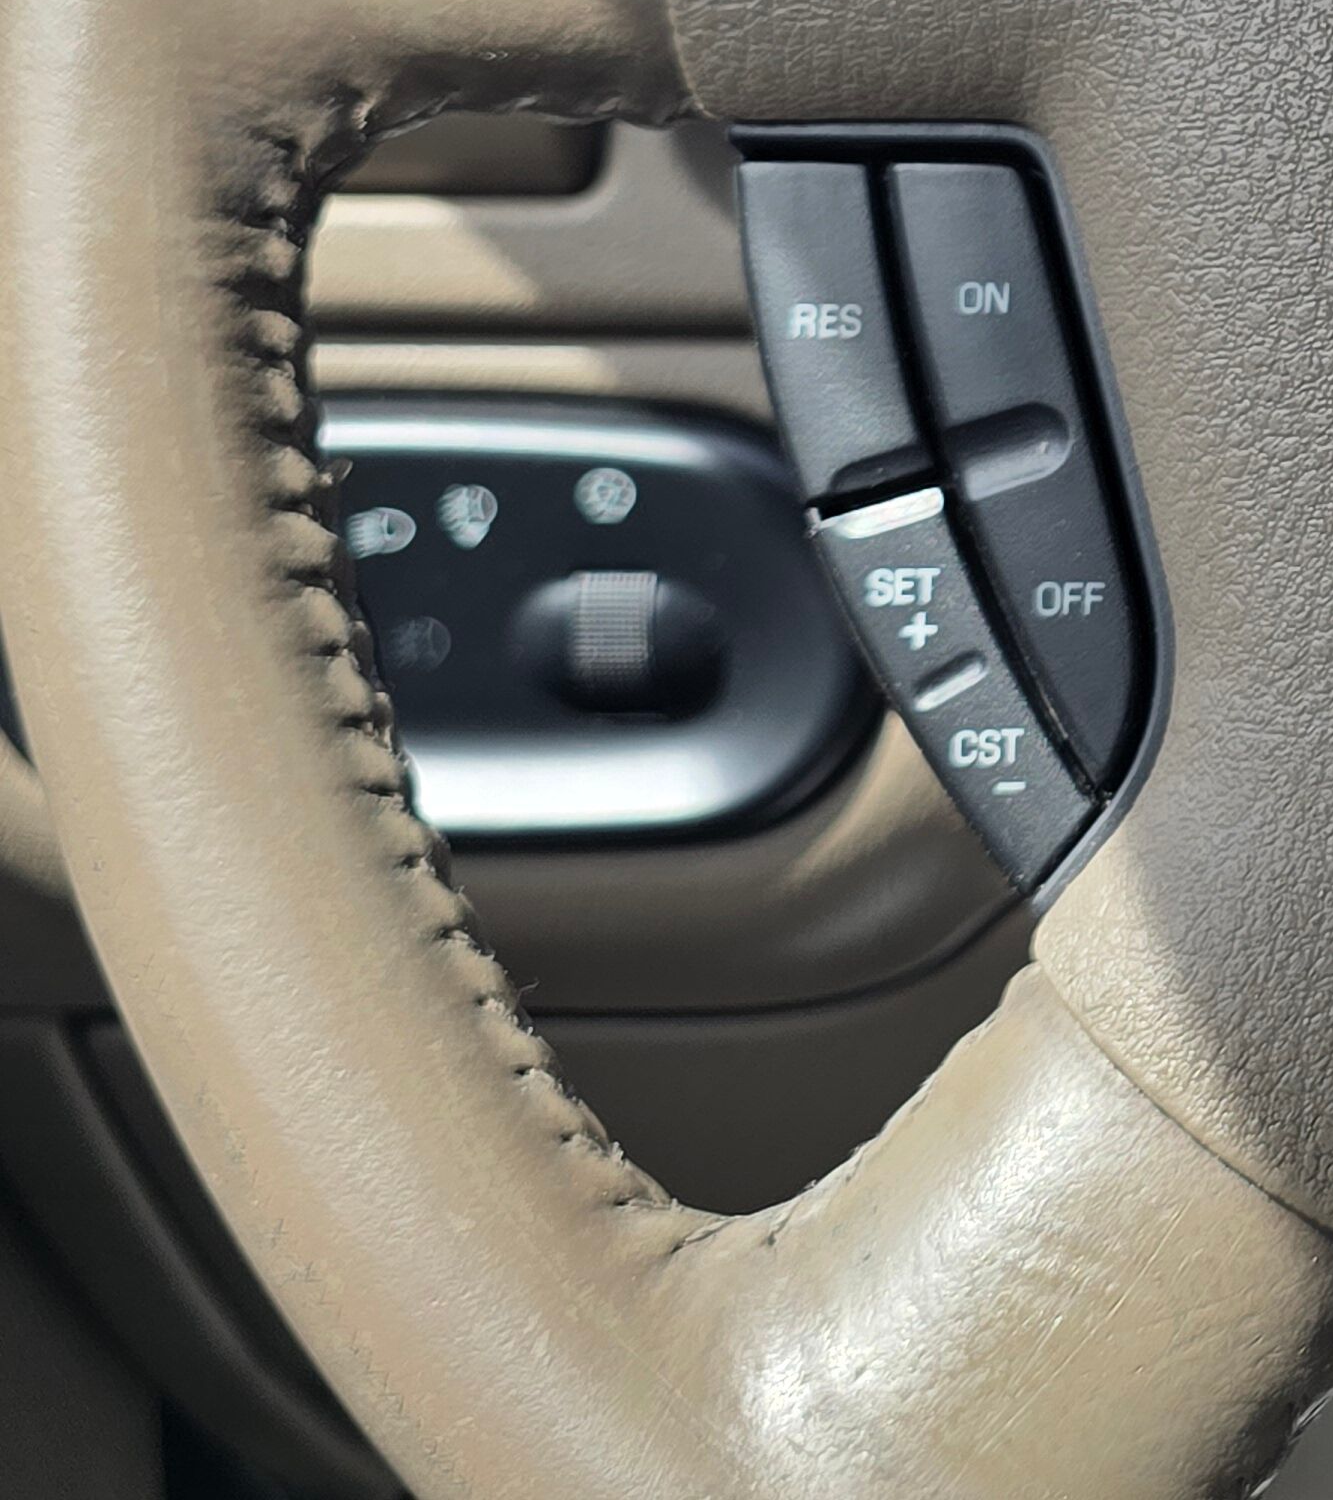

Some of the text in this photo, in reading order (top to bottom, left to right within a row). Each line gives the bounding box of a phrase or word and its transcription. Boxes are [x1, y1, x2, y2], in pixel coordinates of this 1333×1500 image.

[958, 282, 1011, 315] ON
[790, 303, 863, 340] RES
[863, 566, 941, 605] SET
[1034, 581, 1106, 618] OFF
[949, 728, 1025, 767] CST
